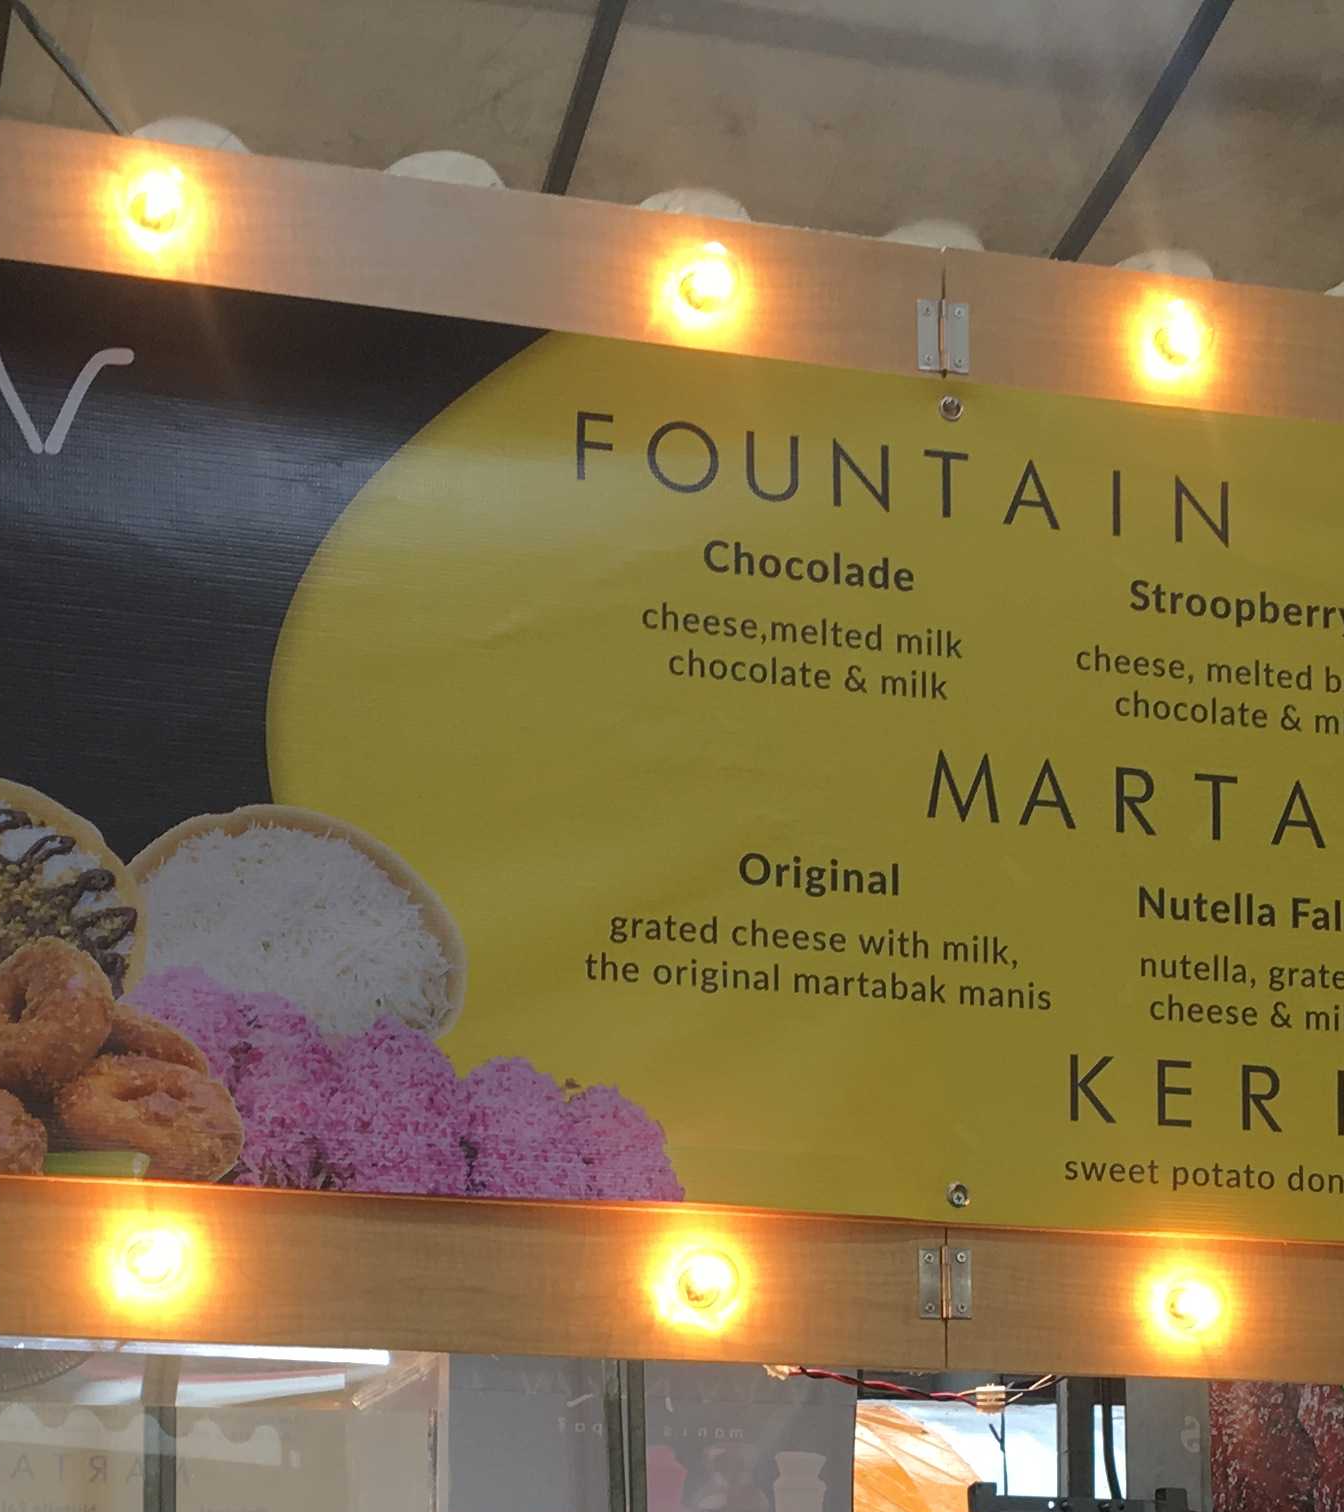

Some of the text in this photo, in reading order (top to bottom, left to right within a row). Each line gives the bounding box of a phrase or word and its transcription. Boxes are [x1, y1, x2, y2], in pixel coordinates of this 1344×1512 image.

[574, 410, 1231, 549] FOUNTAIN
[703, 539, 915, 593] Chocolade
[641, 601, 963, 659] cheese,melted milk
[668, 648, 948, 701] chocolate & milk
[1075, 644, 1194, 685] cheese,
[1206, 659, 1313, 691] melted
[1114, 689, 1268, 729] chocolate
[1280, 704, 1303, 733] &
[738, 852, 900, 898] Original
[1138, 885, 1276, 928] Nutella
[609, 914, 1018, 970] grated cheese with milk,
[584, 951, 1052, 1011] the original martabak manis
[1140, 953, 1256, 989] nutella,
[1149, 993, 1258, 1027] cheese
[1269, 1001, 1293, 1029] &
[1064, 1159, 1160, 1185] sweet
[1172, 1162, 1276, 1192] potato
